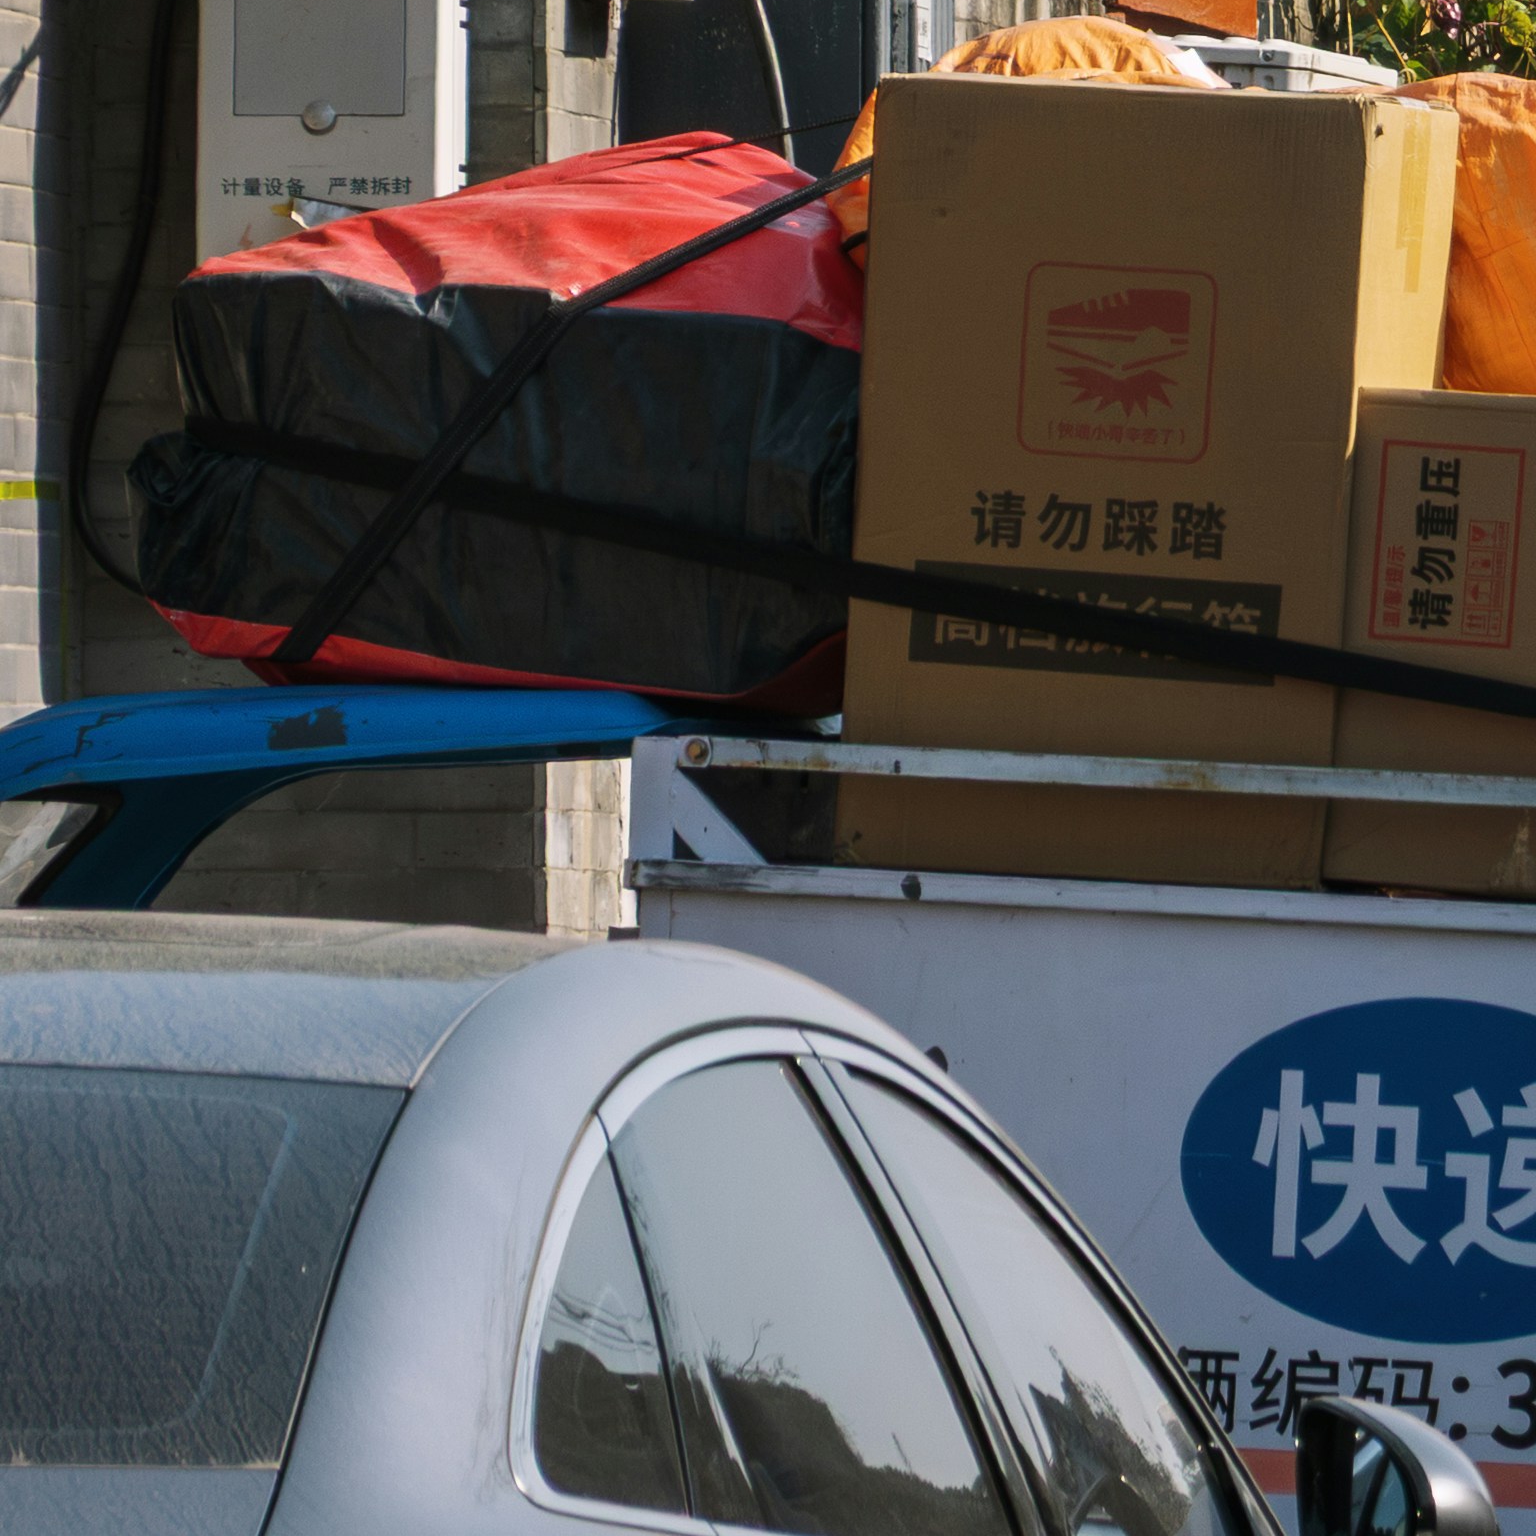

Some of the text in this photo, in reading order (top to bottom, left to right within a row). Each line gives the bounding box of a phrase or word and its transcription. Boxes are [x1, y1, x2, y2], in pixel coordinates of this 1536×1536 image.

[221, 176, 412, 197] 计量设备 严禁拆封
[971, 490, 1228, 560] 请勿踩踏
[1409, 457, 1461, 631] 请勿重压
